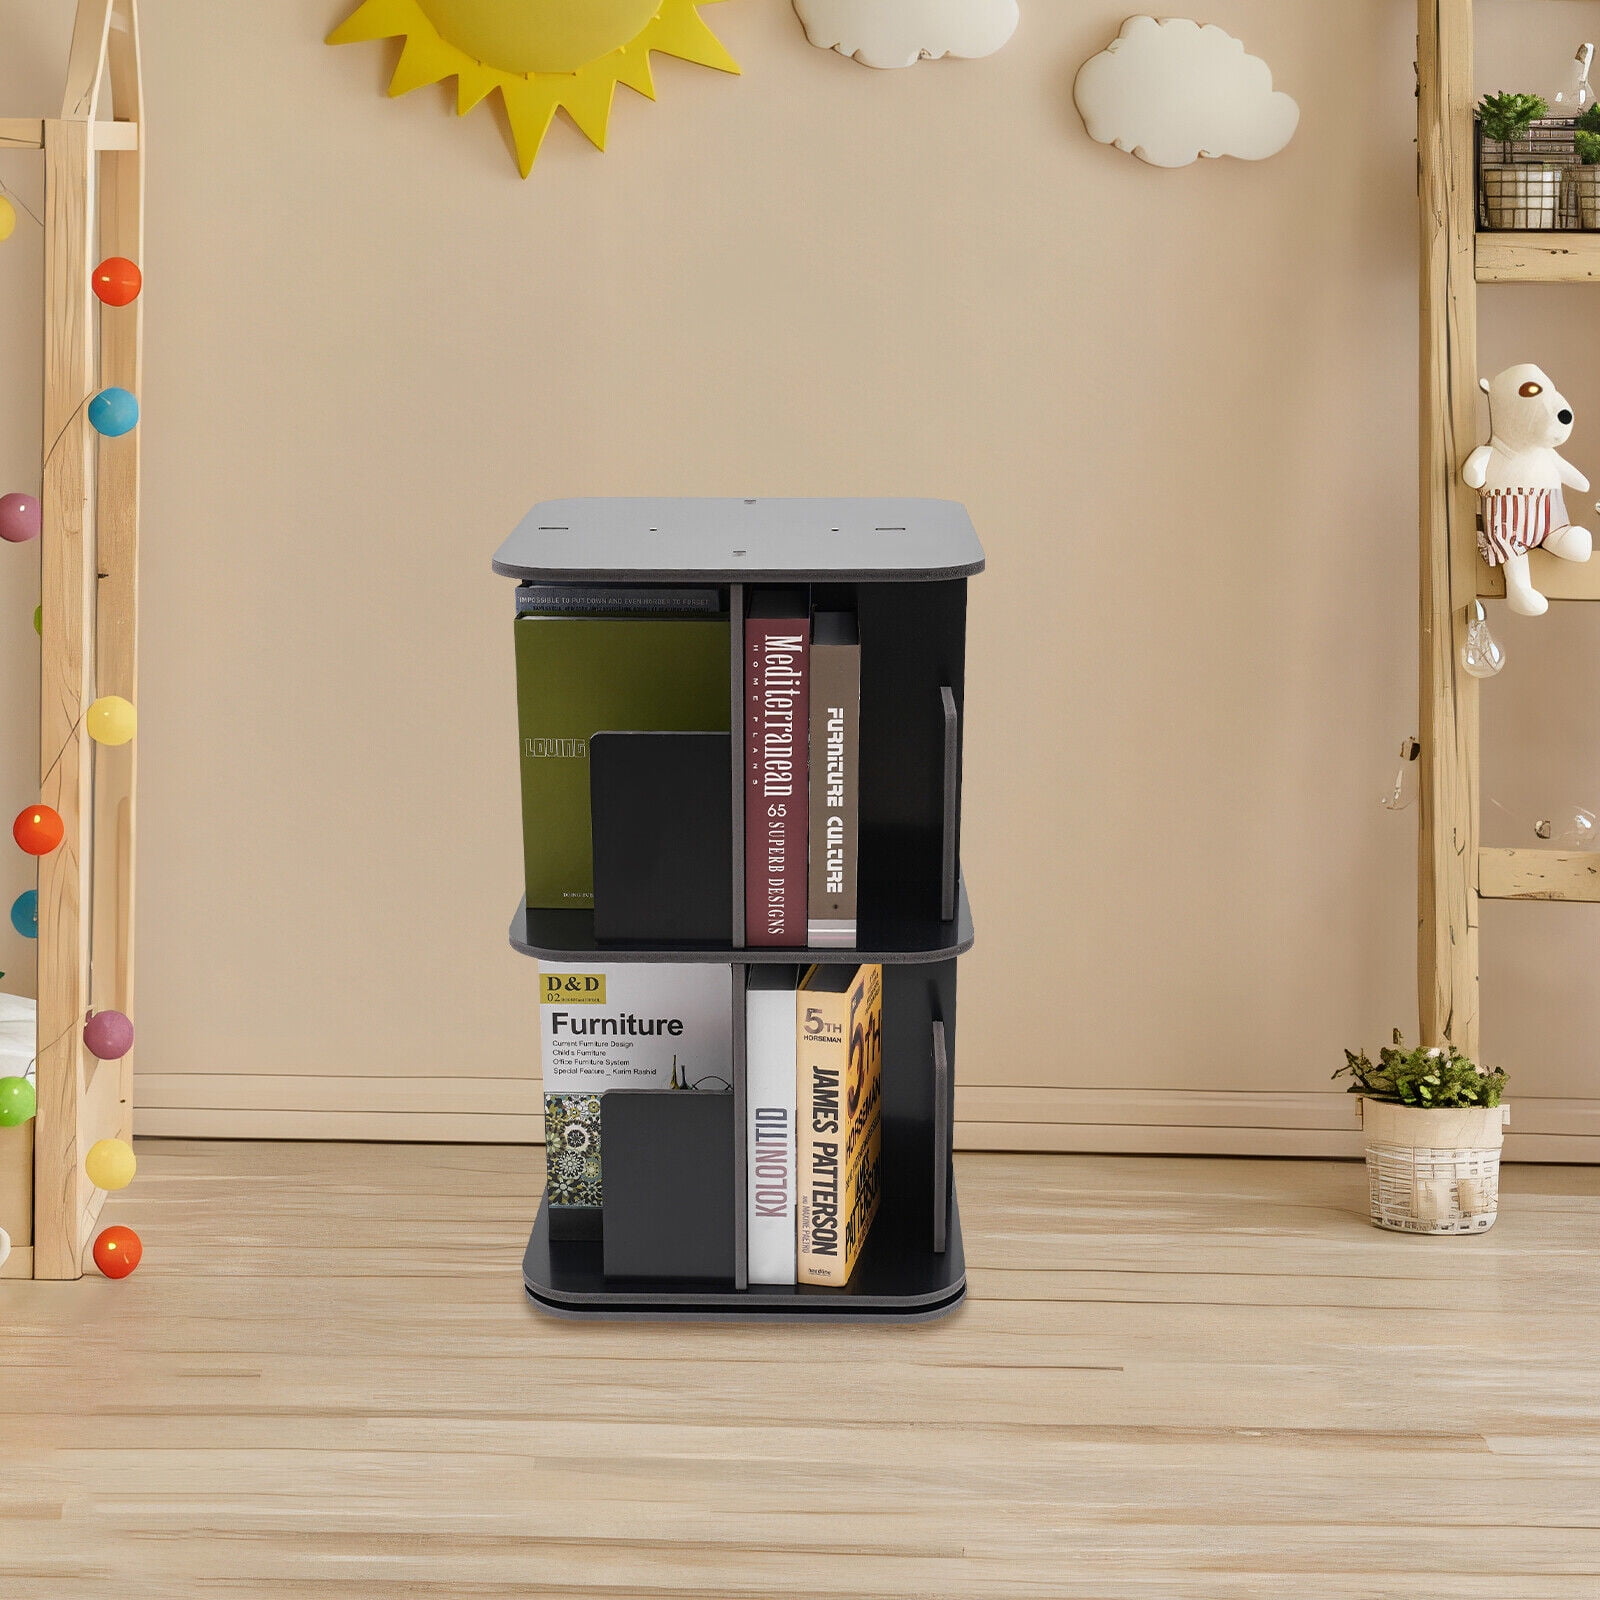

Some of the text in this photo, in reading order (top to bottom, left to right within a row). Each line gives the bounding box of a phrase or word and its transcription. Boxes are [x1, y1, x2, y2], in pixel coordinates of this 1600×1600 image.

[764, 634, 802, 797] Mediterranean
[767, 804, 786, 818] 65
[827, 708, 844, 893] FURNITURE CULTURE
[768, 822, 785, 934] SUPERB DESIGNS
[548, 993, 560, 1002] 02
[552, 1012, 684, 1036] Furniture
[610, 1040, 634, 1049] Design
[804, 1034, 842, 1043] HORSEMAN
[554, 1067, 578, 1075] Special
[756, 1108, 787, 1218] KOLONITID
[812, 1066, 839, 1256] JAMES PATTERSON
